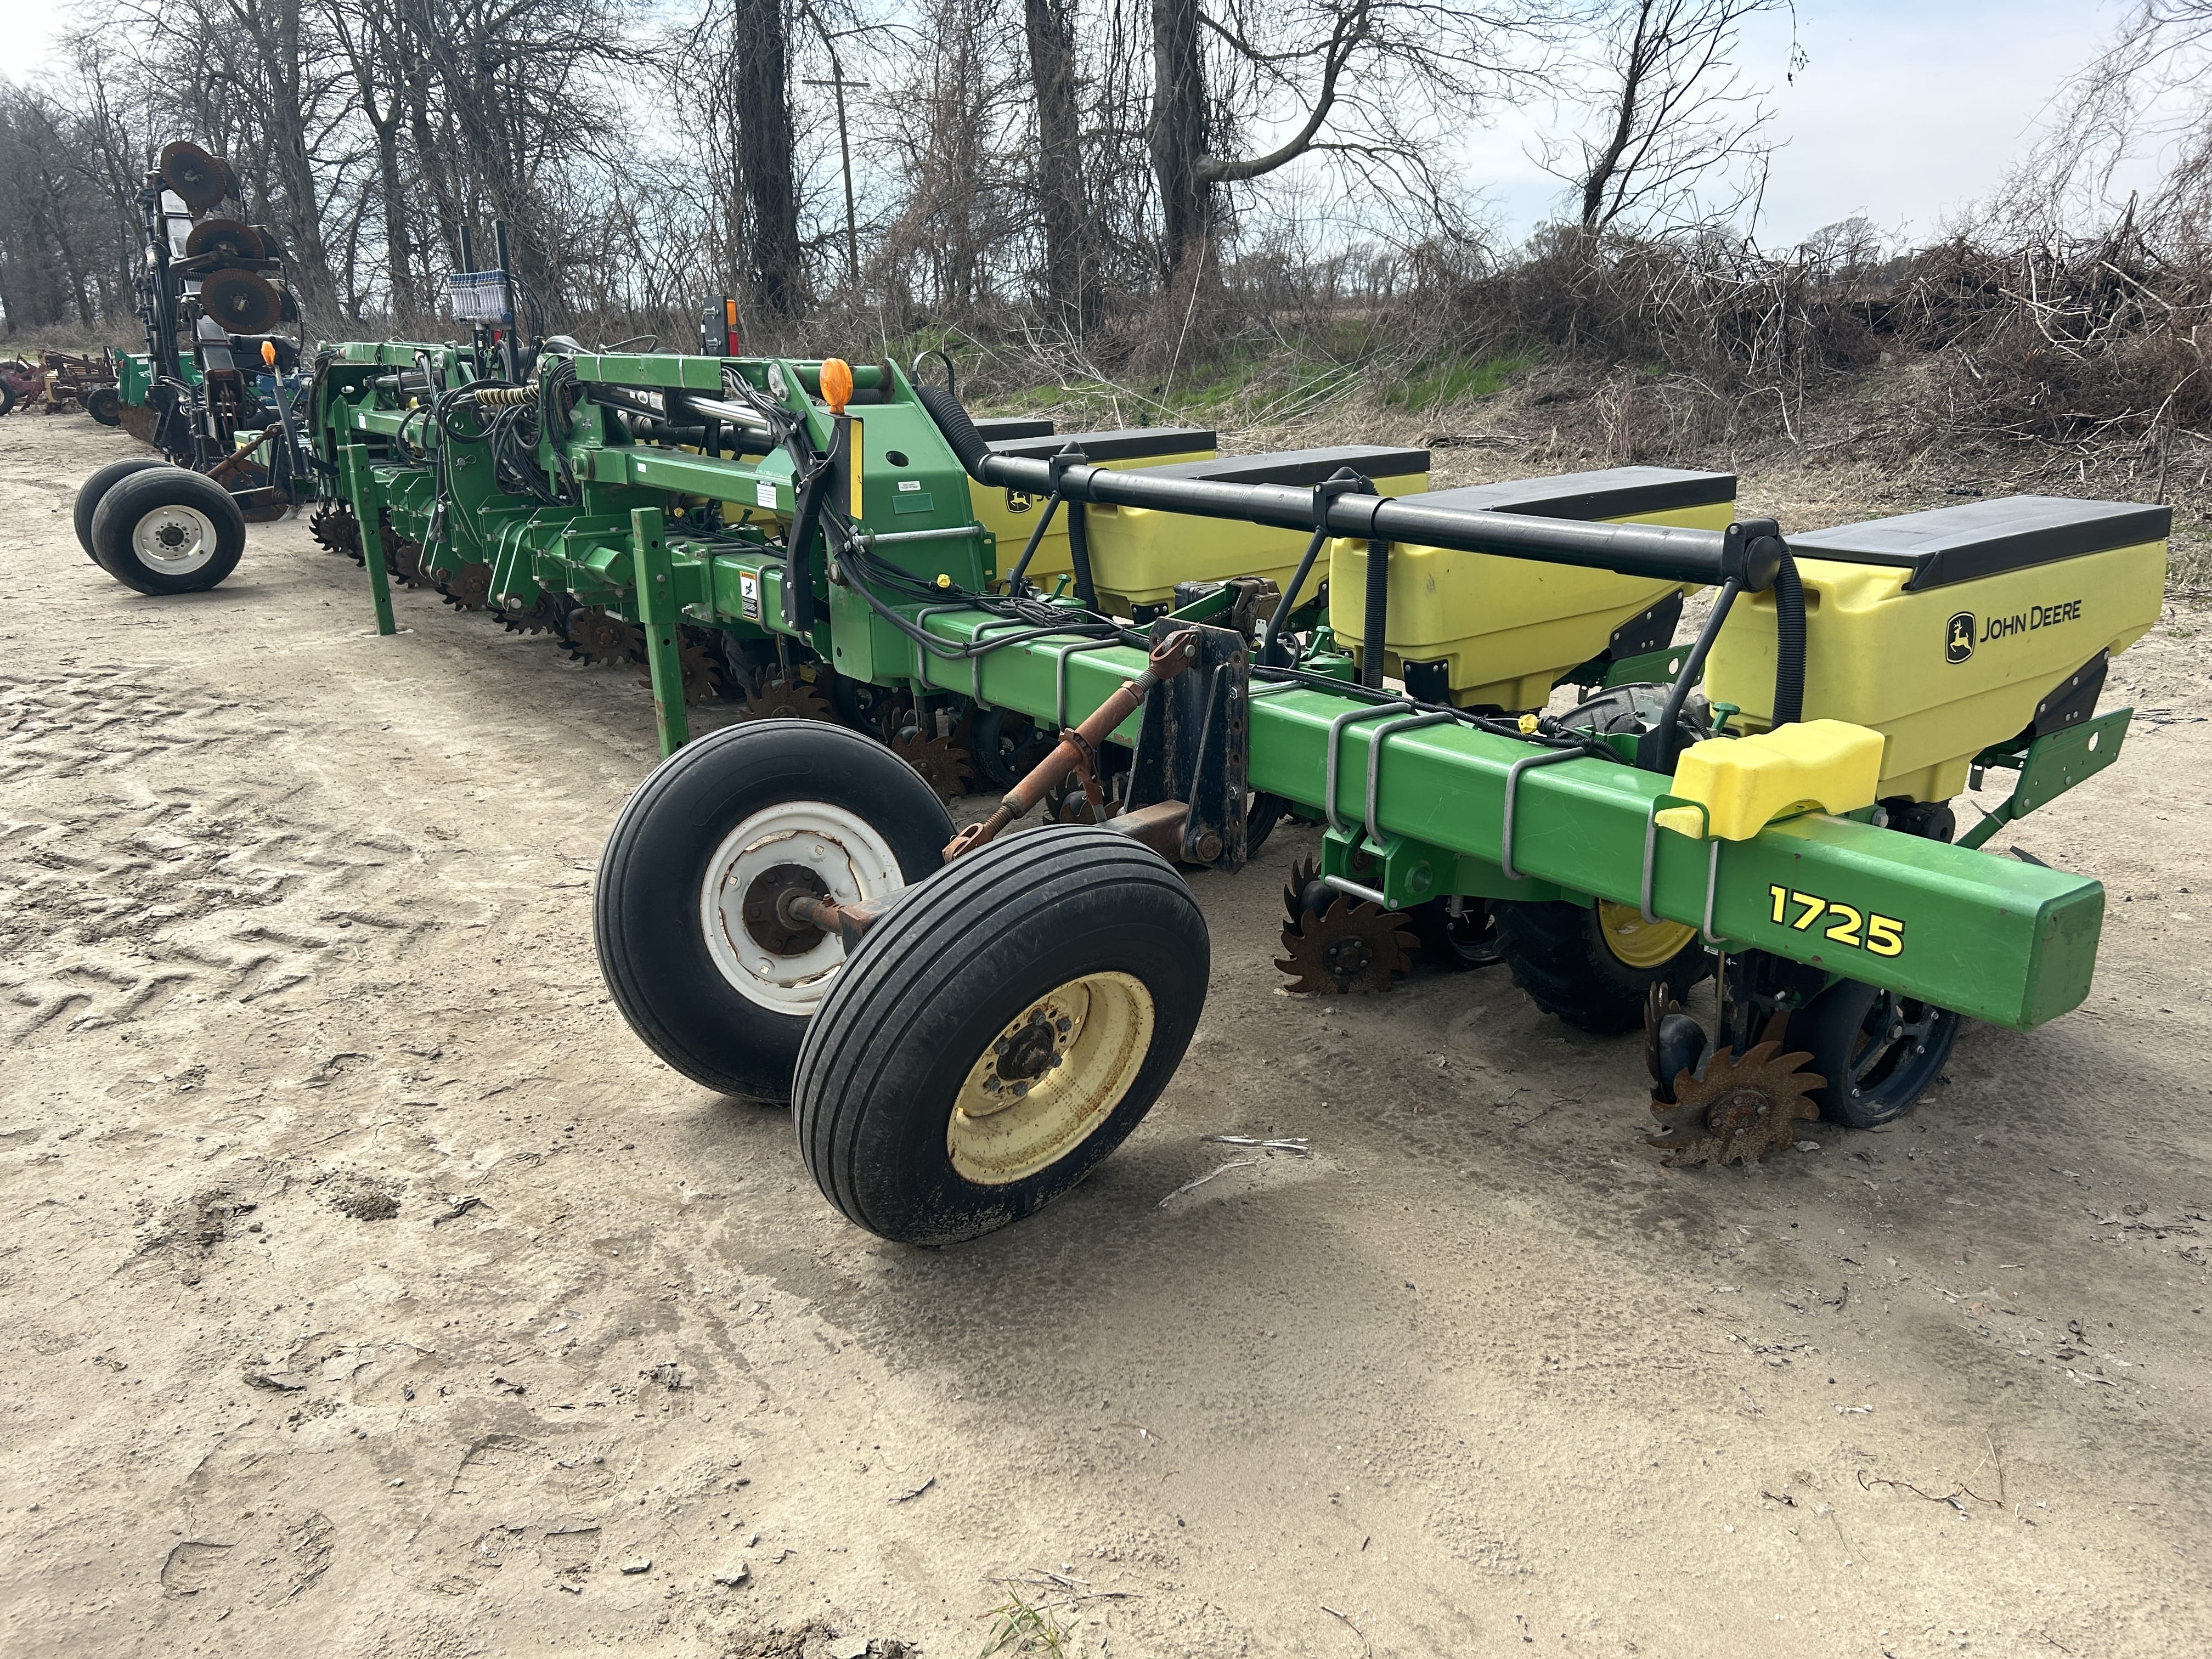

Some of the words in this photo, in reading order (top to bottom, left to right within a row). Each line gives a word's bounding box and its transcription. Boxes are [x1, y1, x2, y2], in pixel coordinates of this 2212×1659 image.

[1980, 613, 2027, 642] JOHN
[2030, 599, 2081, 630] DEERE
[1769, 883, 1906, 958] 1725
